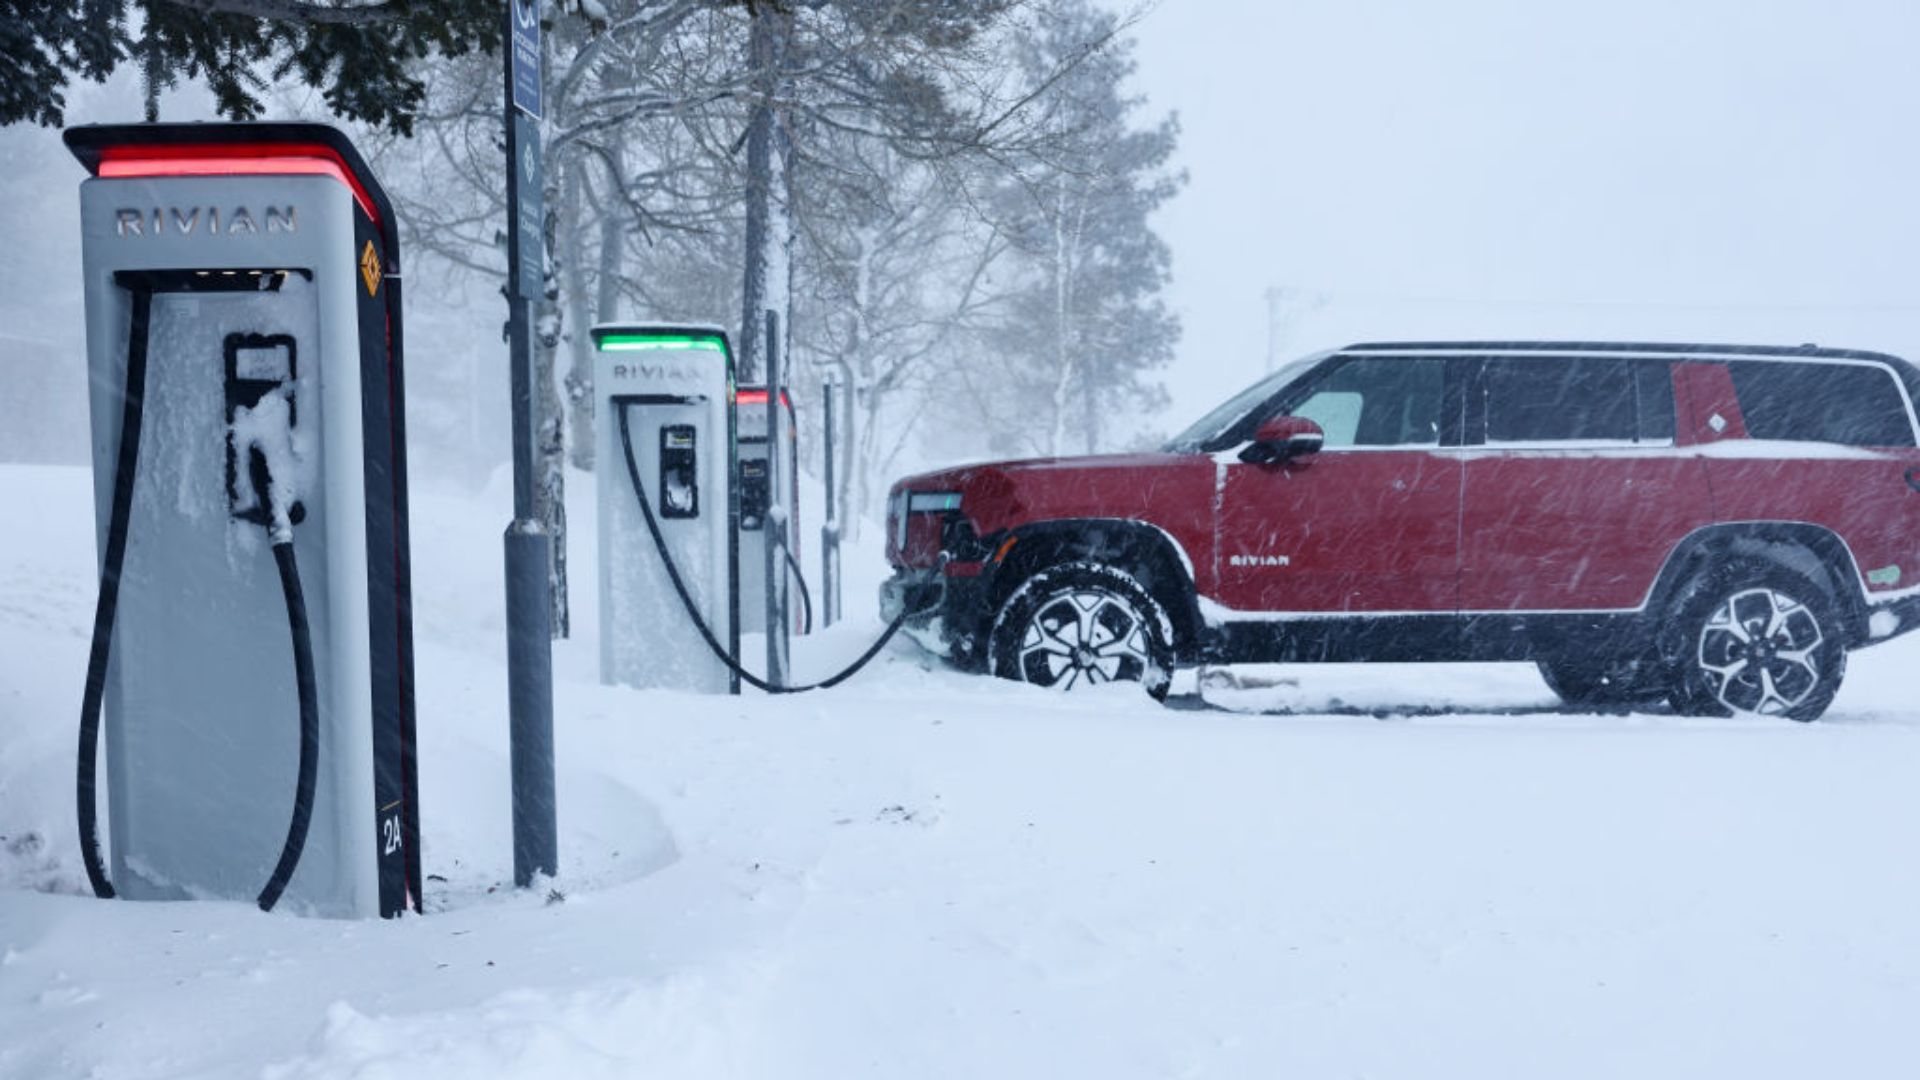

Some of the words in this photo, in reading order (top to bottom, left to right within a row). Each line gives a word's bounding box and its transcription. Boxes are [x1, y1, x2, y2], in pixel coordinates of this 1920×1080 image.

[115, 205, 298, 237] RIVIAN
[1230, 554, 1290, 567] RIVIAN
[384, 814, 402, 856] 2A
